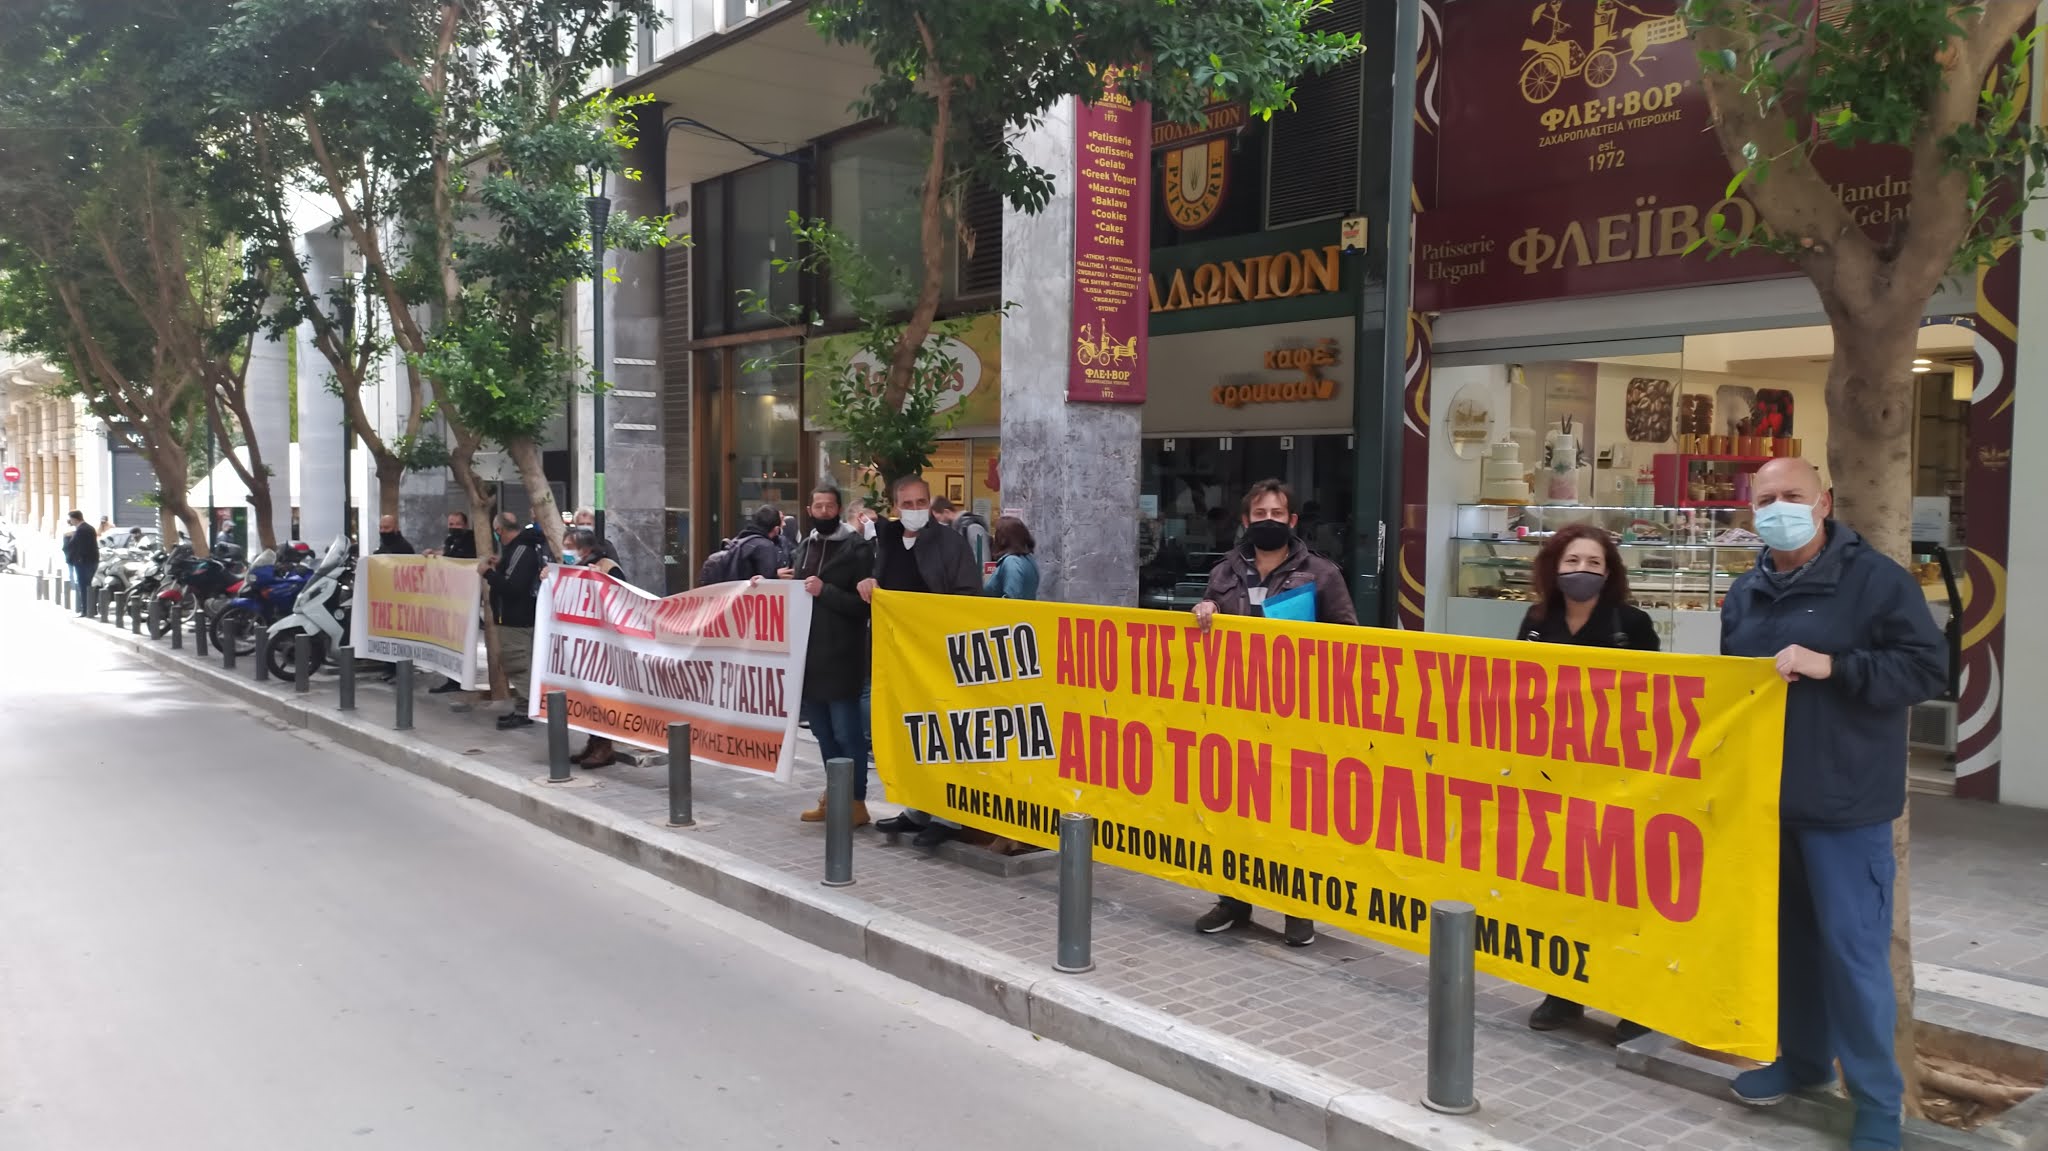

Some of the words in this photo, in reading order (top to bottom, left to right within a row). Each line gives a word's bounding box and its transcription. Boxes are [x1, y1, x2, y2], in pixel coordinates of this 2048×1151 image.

[1092, 131, 1132, 146] Patisserie
[1539, 120, 1624, 148] ΖΑΧΑΡΟΠΛΑΣΤΕΙΑ
[1627, 109, 1682, 131] ΥΠΕΡΟΧΗΣ
[1090, 143, 1134, 160] Confisserie
[1099, 158, 1126, 170] Gelato
[1588, 150, 1626, 172] 1972
[1086, 168, 1110, 180] Greek
[1112, 172, 1137, 185] Yogurt
[1092, 182, 1130, 197] Macarons
[1096, 196, 1128, 209] Baklava
[1096, 209, 1127, 221] Cookies
[1852, 200, 1912, 226] Gelat
[1098, 234, 1125, 246] Coffee
[1099, 222, 1124, 234] Cakes
[1508, 195, 1774, 275] ΦΛΕΪΒΟ
[1422, 234, 1495, 261] Patisserie
[1428, 259, 1487, 285] Elegant
[370, 600, 393, 630] ΤΗΣ
[547, 633, 568, 675] ΤΗΣ
[643, 653, 714, 706] ΣΥΜΒΑΣΗΣ
[719, 661, 788, 718] ΕΡΓΑΣΙΑΣ
[946, 622, 1042, 687] ΚΑΤΩ
[1057, 616, 1118, 692] ΑΠΟ
[1126, 621, 1175, 699] ΤΙΣ
[1184, 626, 1404, 736] ΣΥΛΛΟΓΙΚΕΣ
[1413, 649, 1705, 780] ΣΥΜΒΑΣΕΙΣ
[540, 694, 621, 727] ΕΖΟΜΕΝΟΙ
[623, 713, 669, 738] ΕΘΝΙΚΗ
[690, 727, 724, 753] ΡΙΚΗΣ
[726, 736, 782, 765] ΣΚΗΝΗ
[904, 711, 950, 764] ΤΑ
[948, 702, 1056, 763] ΚΕΡΙΑ
[1058, 711, 1153, 796] ΑΠΟ
[1166, 726, 1272, 824] ΤΟΝ
[1290, 748, 1704, 923] ΠΟΛΙΤΙΣΜΟ
[946, 783, 1061, 836] ΠΑΝΕΛΛΗΝΙΑ
[1092, 817, 1213, 876] ΟΣΠΟΝΔΙΑ
[1222, 848, 1357, 917] ΘΕΑΜΑΤΟΣ
[1368, 887, 1591, 984] ΑΚΡΜΑΤΟΣ
